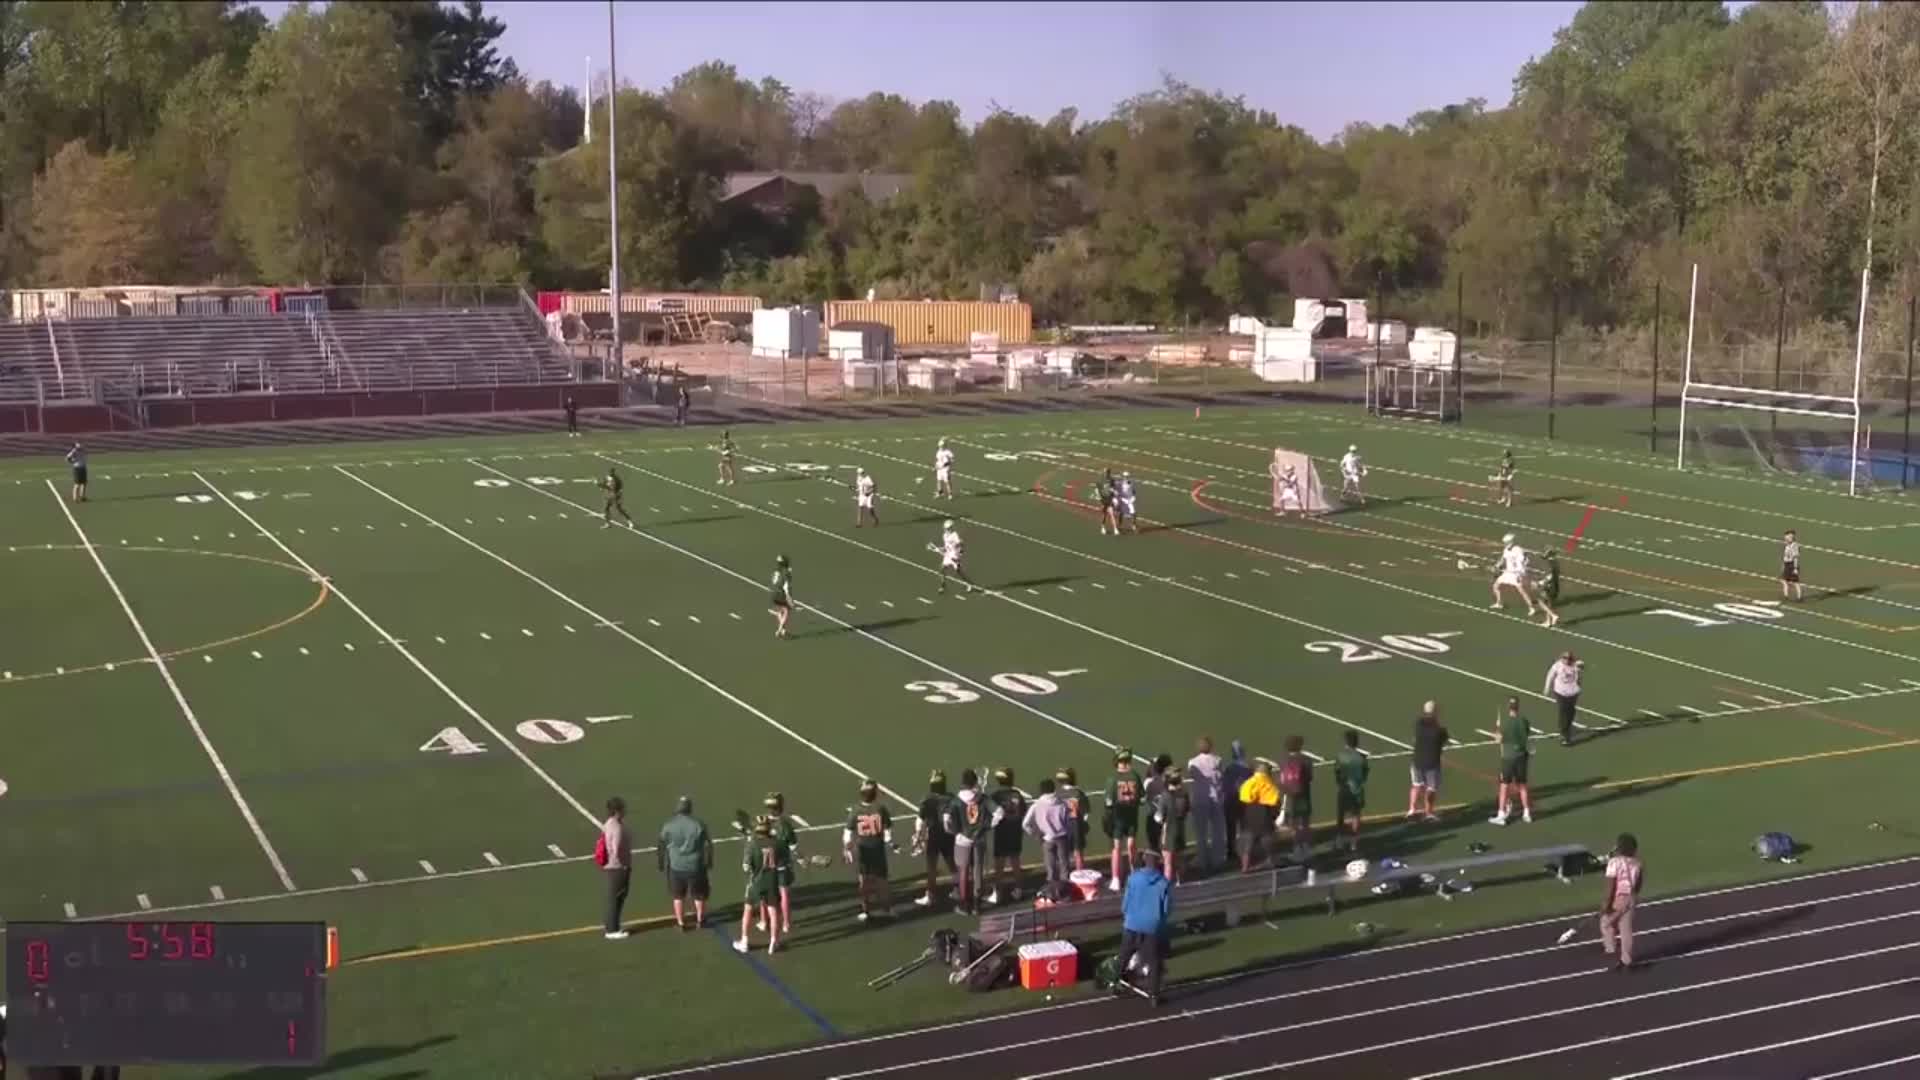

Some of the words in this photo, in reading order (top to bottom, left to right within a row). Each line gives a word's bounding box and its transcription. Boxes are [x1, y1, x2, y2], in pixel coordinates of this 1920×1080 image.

[1304, 635, 1451, 663] 20
[904, 672, 1059, 704] 30
[419, 719, 585, 755] 40
[856, 814, 882, 837] 20
[1047, 959, 1060, 975] G
